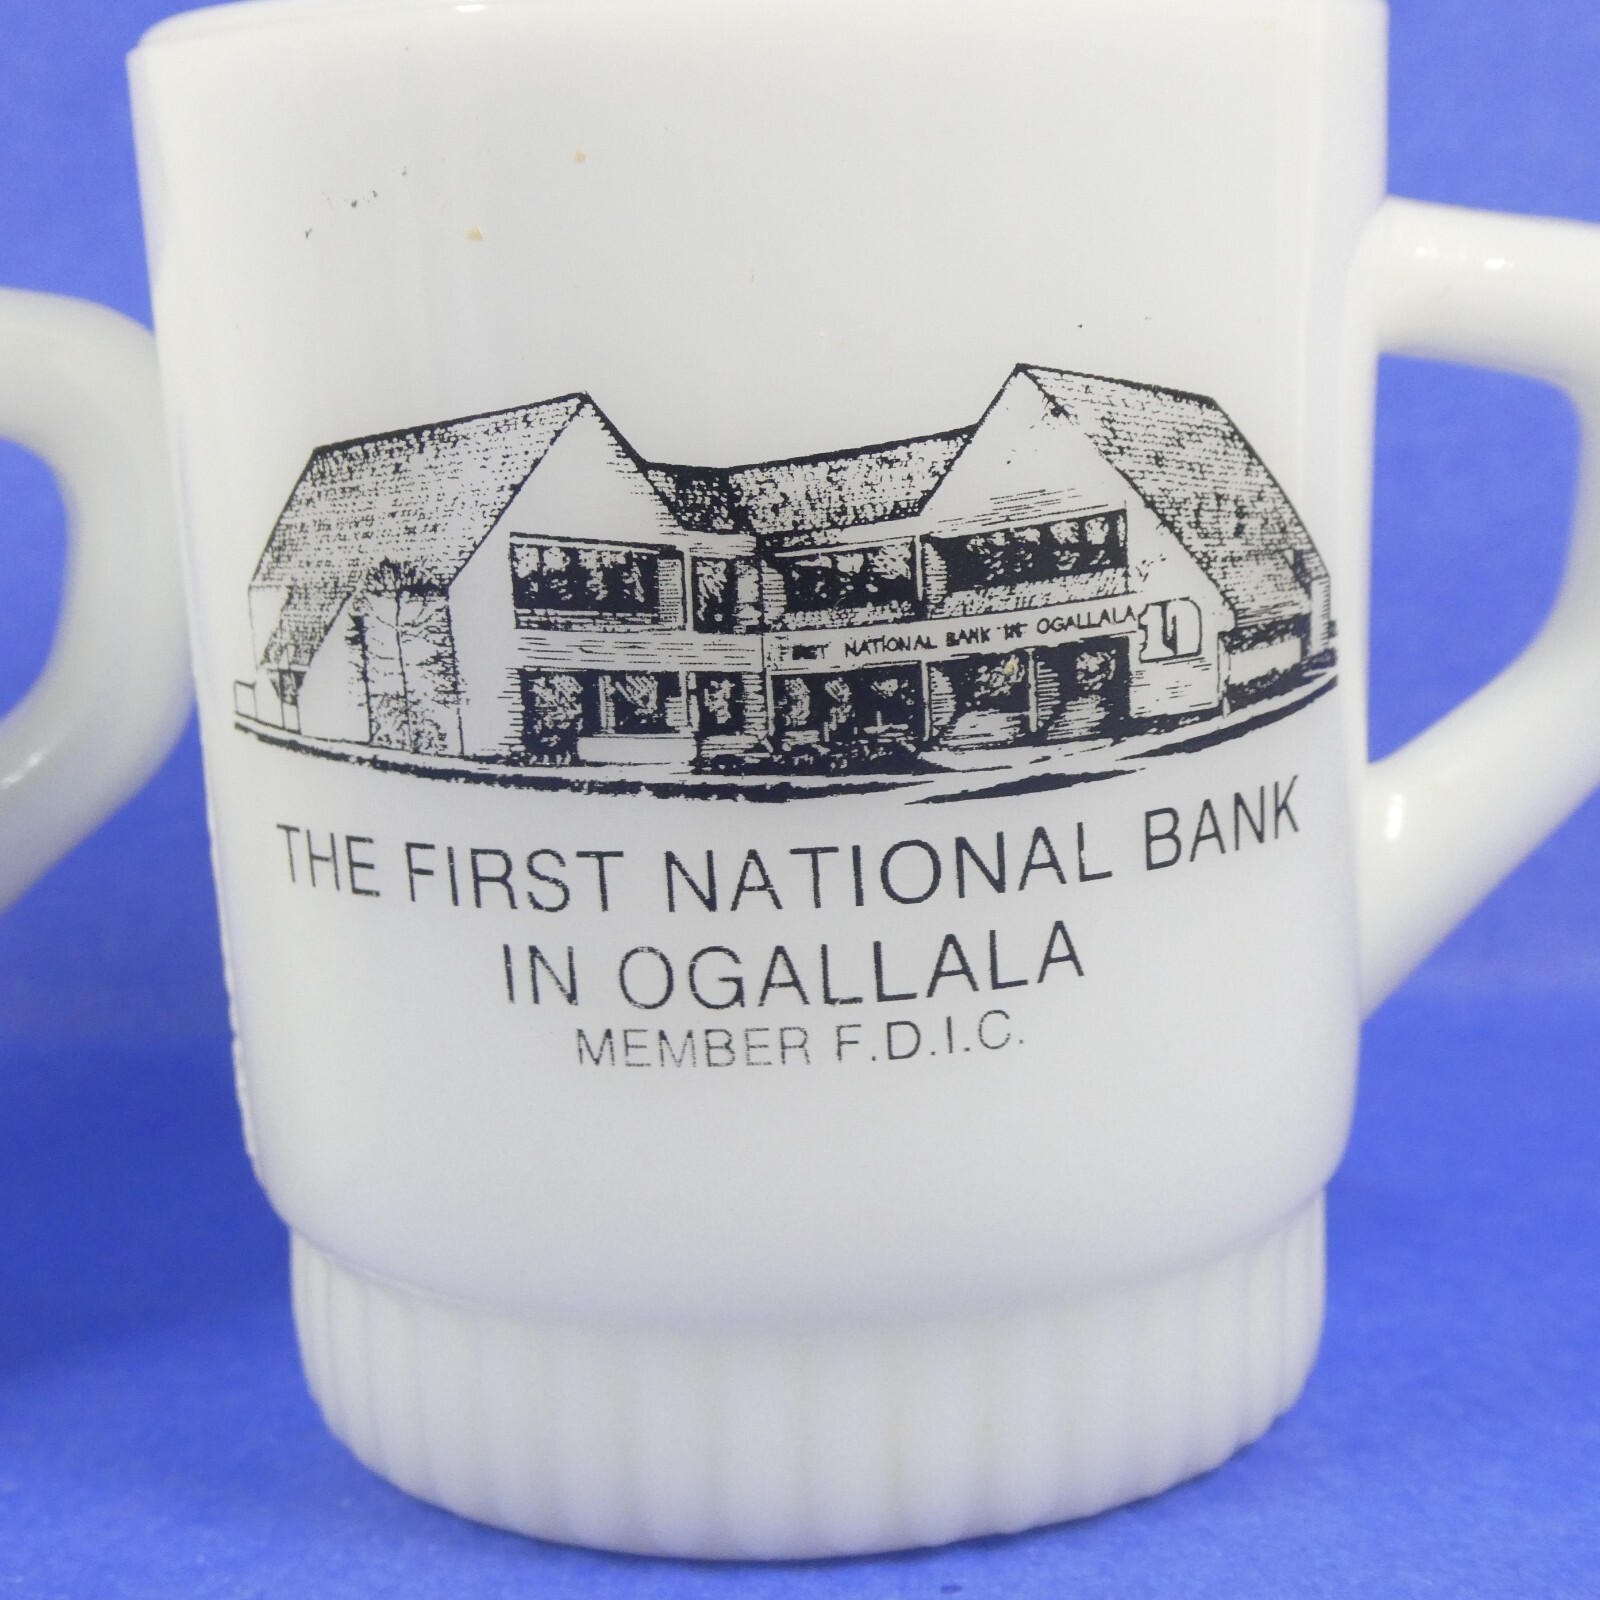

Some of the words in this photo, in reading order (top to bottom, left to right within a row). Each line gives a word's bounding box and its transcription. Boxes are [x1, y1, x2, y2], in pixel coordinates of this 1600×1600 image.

[844, 634, 938, 658] NATIONAL
[946, 626, 991, 647] BANK
[1036, 605, 1136, 634] OGALLALA
[277, 824, 381, 898] THE
[406, 842, 625, 913] FIRST
[664, 822, 1113, 913] NATIONAL
[1145, 775, 1300, 872] BANK
[503, 944, 579, 1007] IN
[618, 920, 1084, 1011] OGALLALA
[576, 1027, 811, 1068] MEMBER
[836, 1009, 1025, 1062] F.D.I.C.
